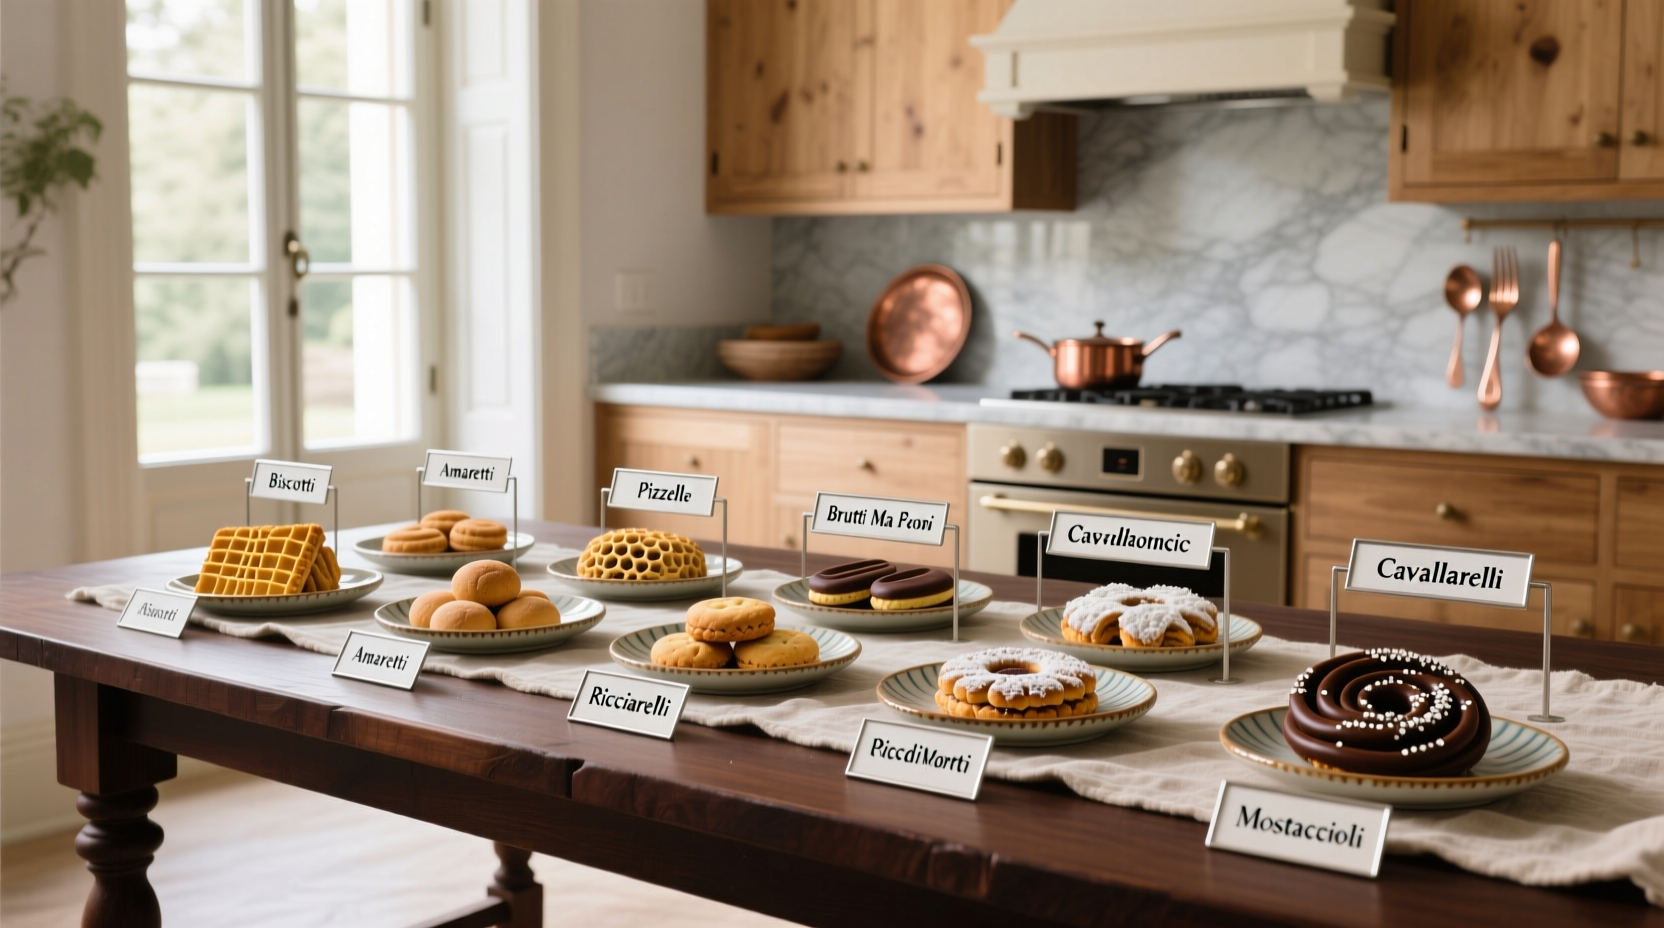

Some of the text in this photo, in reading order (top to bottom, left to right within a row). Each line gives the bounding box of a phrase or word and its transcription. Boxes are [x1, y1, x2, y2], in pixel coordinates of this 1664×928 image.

[439, 462, 495, 481] Amaretti
[637, 481, 692, 503] Pizzelle
[826, 505, 867, 525] Brutti
[870, 509, 893, 528] Ma
[1377, 557, 1504, 590] Cavallarelli
[351, 645, 409, 671] Amaretti
[589, 686, 671, 717] Ricciarelli
[1236, 805, 1365, 849] Mostaccioli
